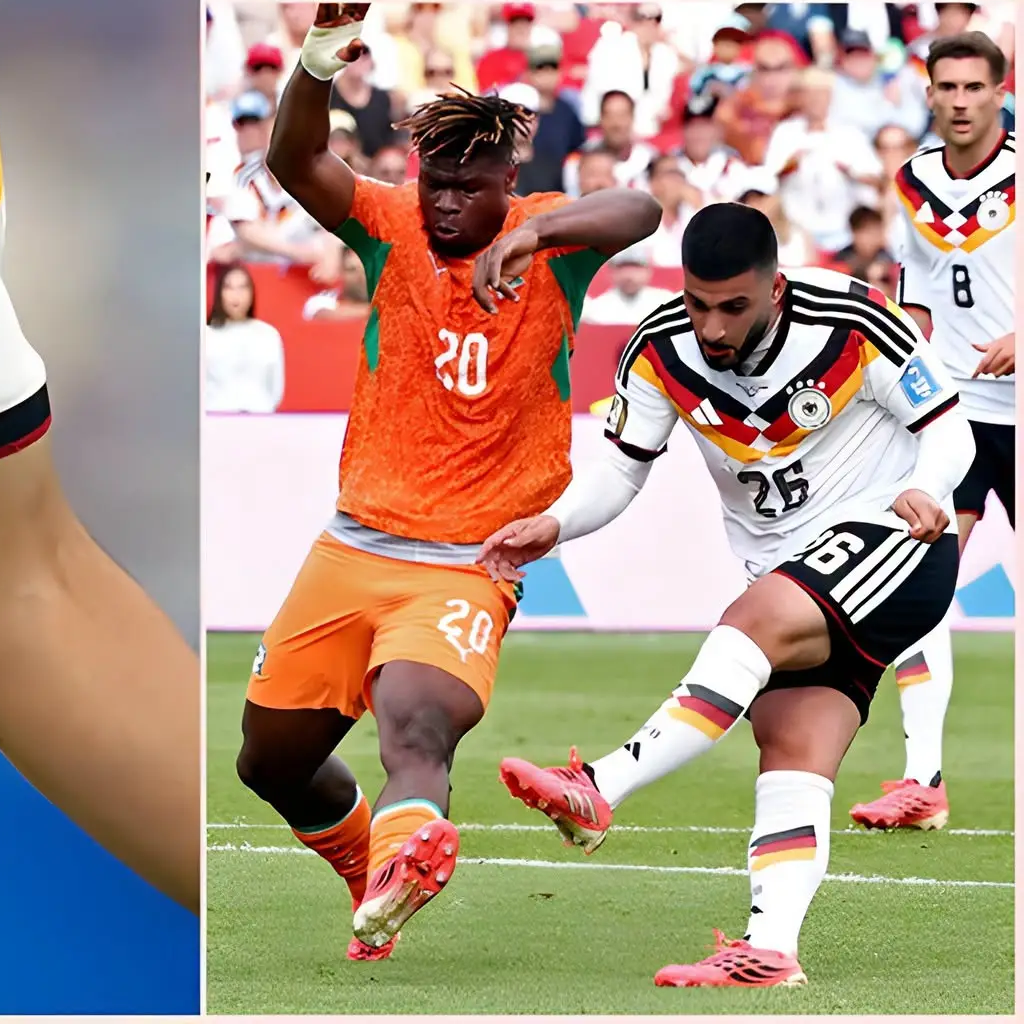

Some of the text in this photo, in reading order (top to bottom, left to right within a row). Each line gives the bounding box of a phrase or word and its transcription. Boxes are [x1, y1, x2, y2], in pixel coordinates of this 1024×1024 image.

[952, 264, 974, 308] 8
[434, 327, 488, 396] 20
[737, 459, 809, 518] 26
[437, 598, 494, 663] 20
